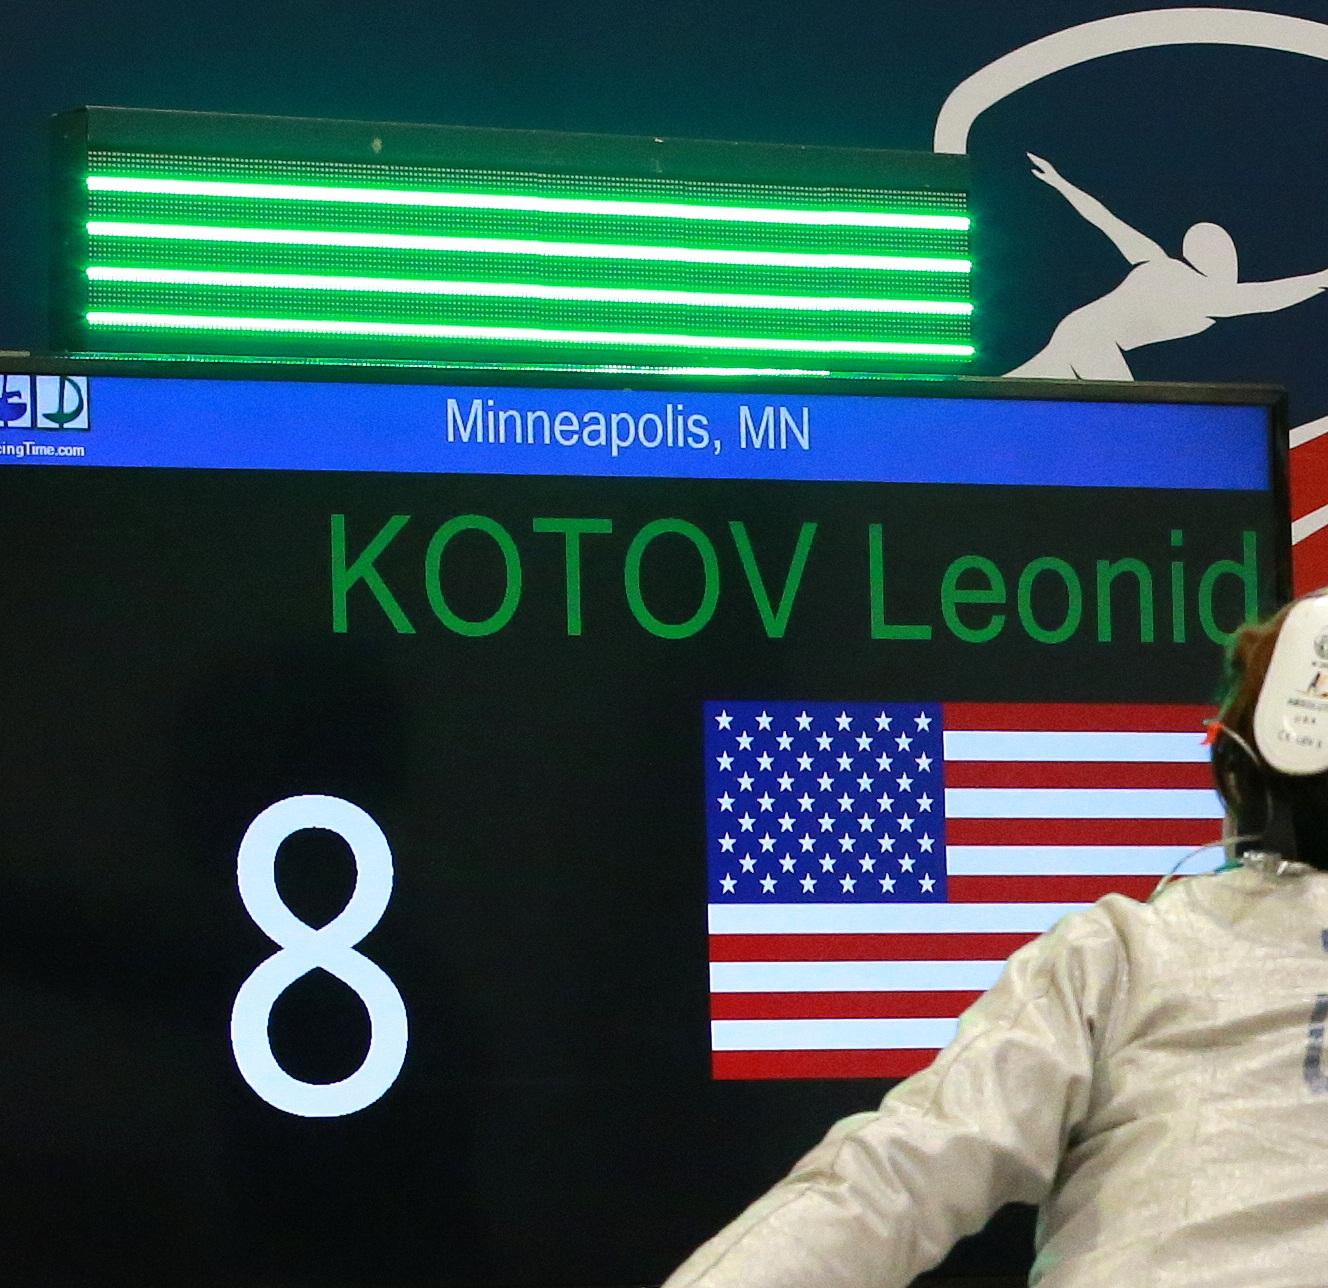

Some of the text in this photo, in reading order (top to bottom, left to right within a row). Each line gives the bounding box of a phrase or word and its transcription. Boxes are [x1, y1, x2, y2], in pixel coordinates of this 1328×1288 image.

[0, 440, 86, 458] ingTime.com
[446, 398, 811, 459] Minneapolis, MN
[331, 514, 1259, 646] KOTOV Leonid
[230, 794, 409, 1118] 8
